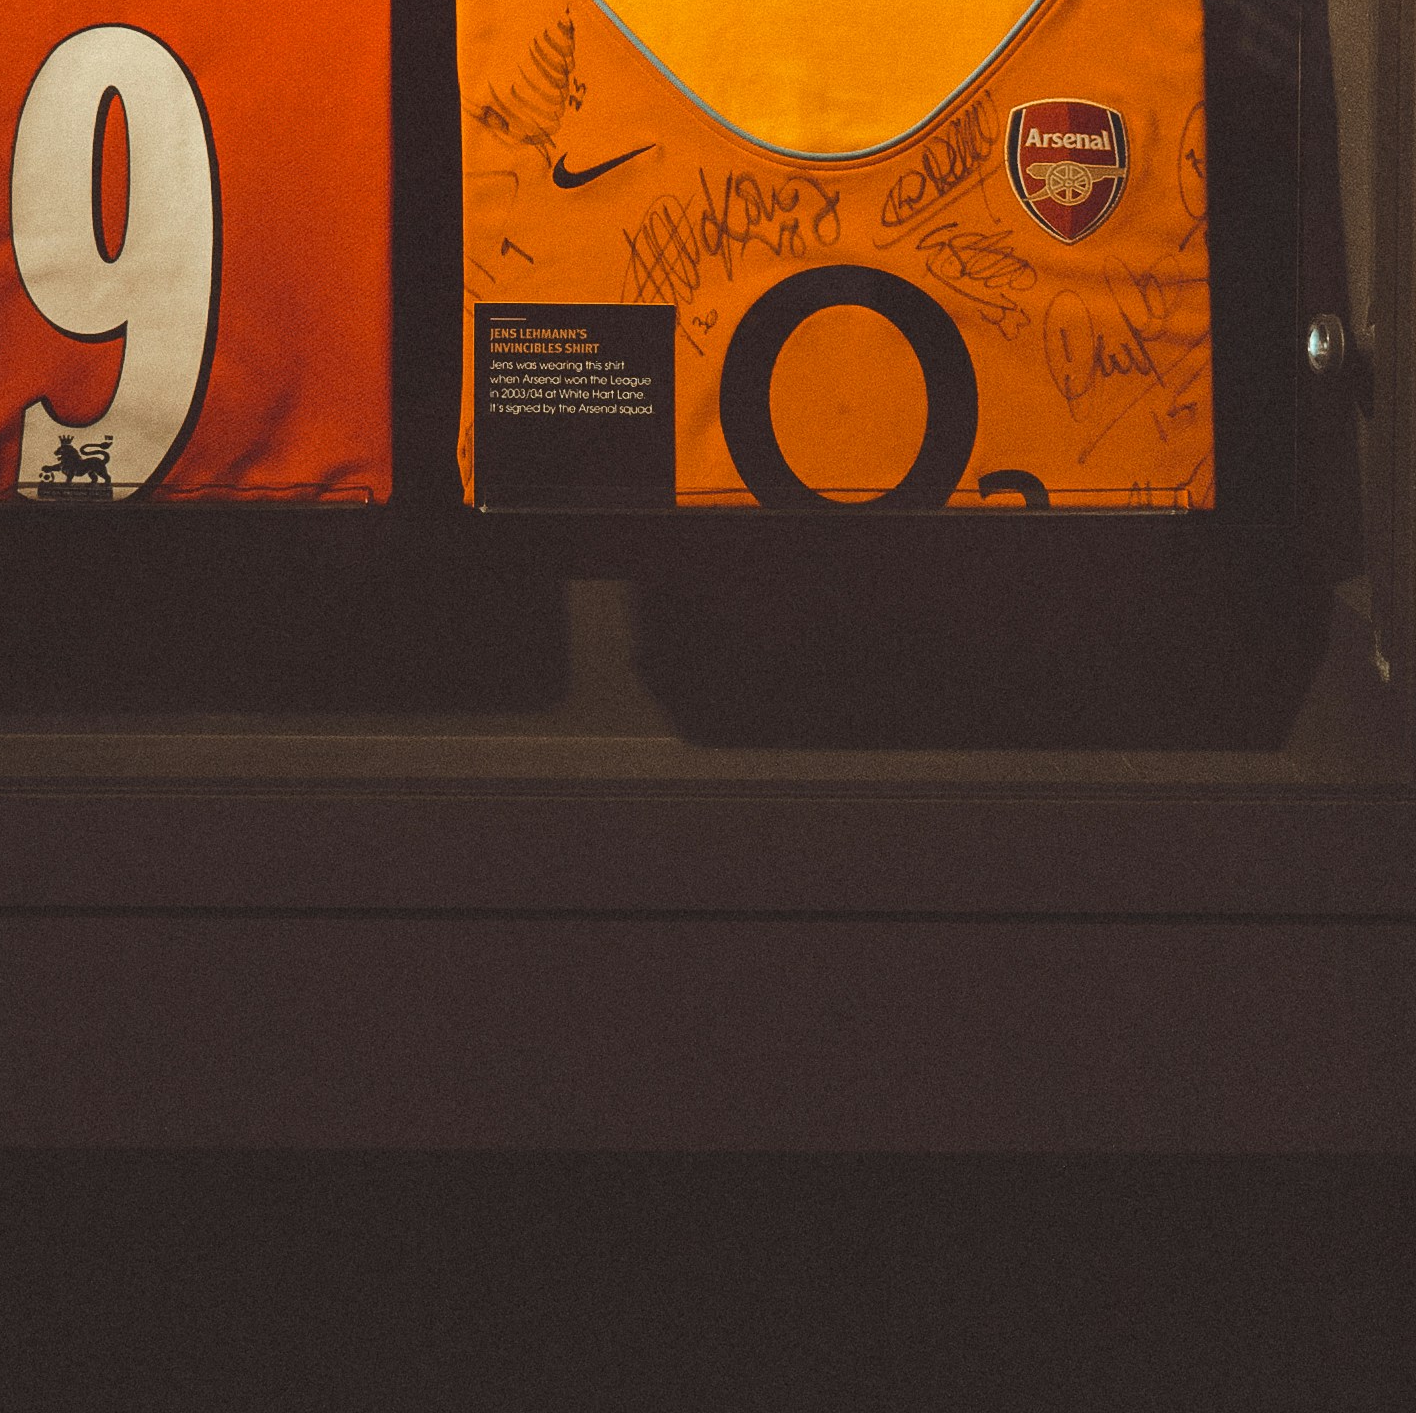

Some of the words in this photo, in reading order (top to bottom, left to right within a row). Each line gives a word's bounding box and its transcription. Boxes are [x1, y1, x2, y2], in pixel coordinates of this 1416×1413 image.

[1025, 128, 1111, 150] Arsenal
[490, 329, 516, 340] JENS
[520, 329, 587, 339] LEHMANN'S
[490, 343, 562, 353] INVINCIBLES
[565, 343, 600, 353] SHIRT
[490, 360, 513, 369] Jens
[540, 361, 582, 372] wearing
[586, 361, 602, 370] this
[604, 361, 624, 370] shirt
[490, 375, 519, 384] when
[522, 375, 561, 384] Arsenal
[590, 375, 607, 384] the
[610, 376, 651, 387] League
[490, 389, 499, 398] in
[501, 388, 543, 399] 2003/04
[545, 389, 556, 399] at
[559, 389, 589, 399] White
[592, 389, 614, 399] Hart
[617, 390, 645, 399] Lane.
[490, 403, 503, 413] It's
[506, 403, 540, 414] signed
[543, 403, 555, 414] by
[559, 404, 576, 413] the
[579, 404, 617, 414] Arsenal
[619, 404, 655, 416] squad.
